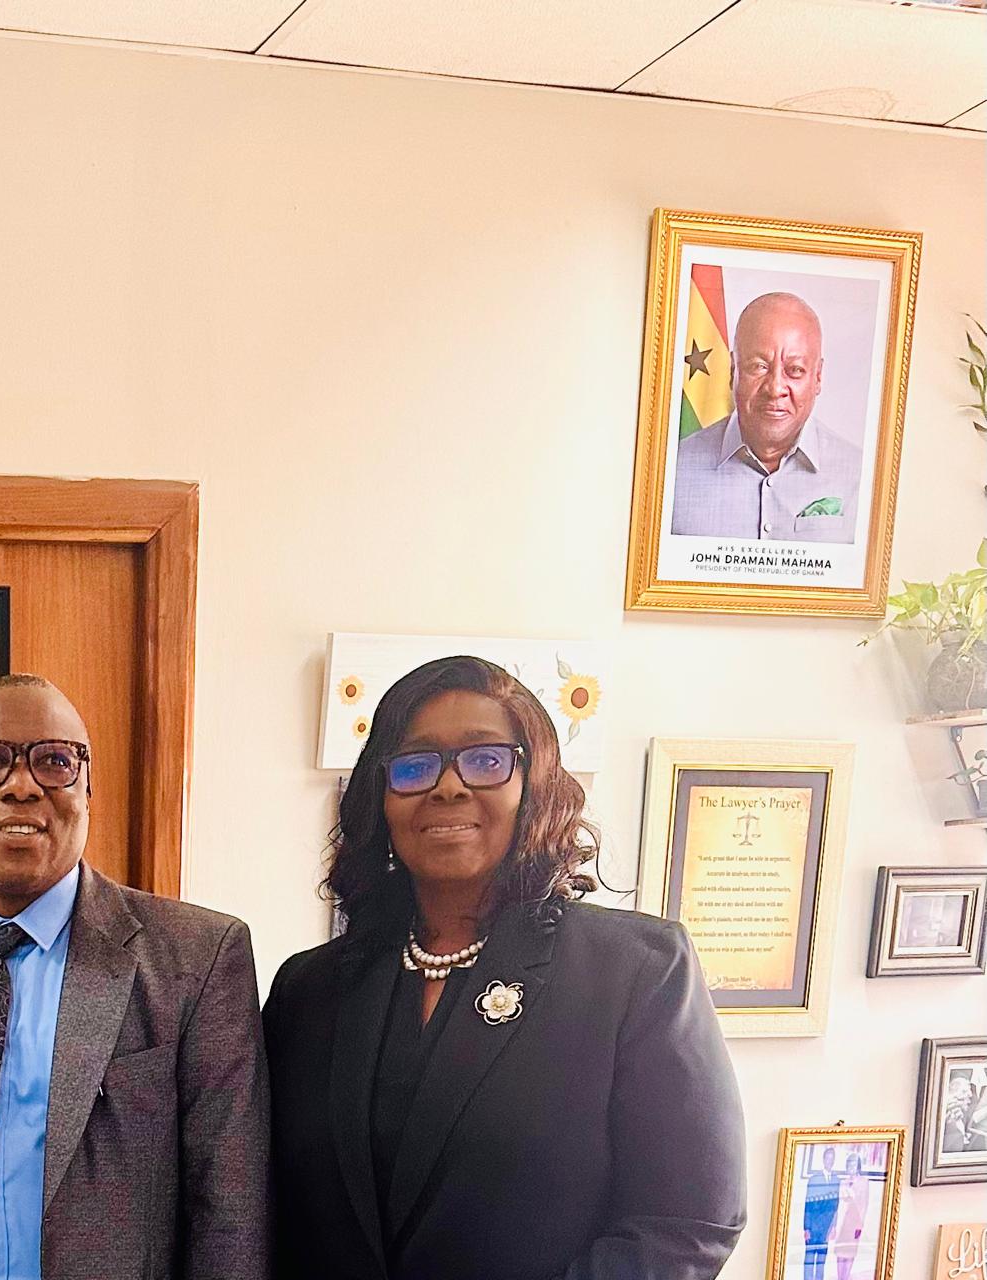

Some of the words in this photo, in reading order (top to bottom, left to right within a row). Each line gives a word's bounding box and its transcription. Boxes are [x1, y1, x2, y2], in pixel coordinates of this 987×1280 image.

[741, 547, 807, 555] EXCELLENCY
[690, 553, 720, 563] JOHN
[725, 554, 778, 566] DRAMANI
[781, 557, 832, 569] MAHAMA
[695, 564, 731, 572] PRESIDENT
[699, 796, 718, 808] The
[720, 796, 766, 811] Lawyer's
[769, 797, 801, 812] Prayer
